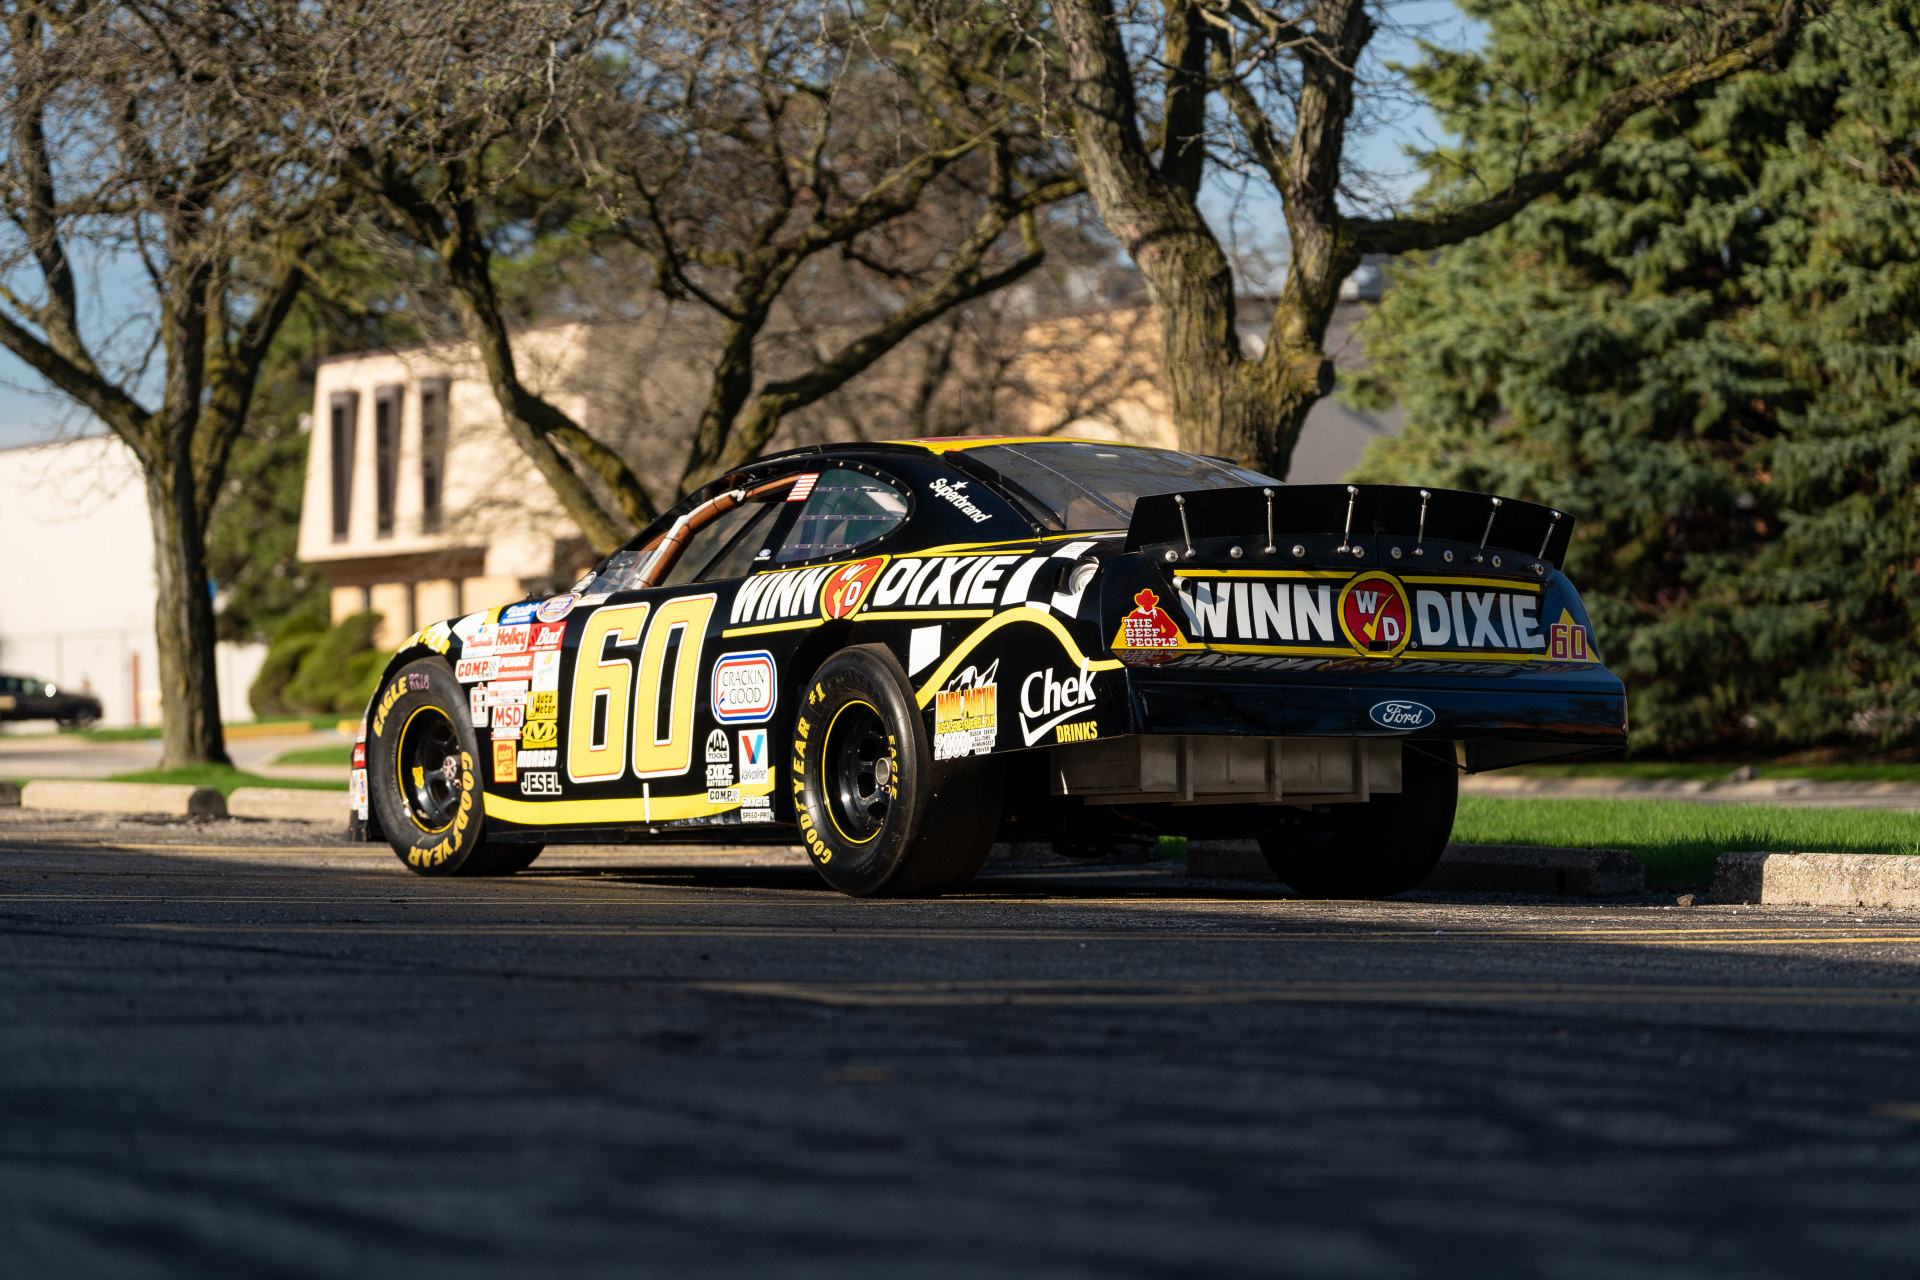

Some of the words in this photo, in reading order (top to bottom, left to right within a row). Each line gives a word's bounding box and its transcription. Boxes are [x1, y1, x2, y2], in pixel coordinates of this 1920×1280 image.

[929, 477, 992, 524] Superbrand
[872, 555, 1022, 607] DIXIE
[730, 567, 829, 624] WINN
[1355, 590, 1378, 614] W
[1123, 618, 1153, 628] THE
[1178, 581, 1335, 642] WINN
[1416, 589, 1546, 649] DIXIE
[495, 626, 528, 651] Holley
[535, 625, 565, 646] Bud
[1125, 628, 1161, 638] BEEF
[1382, 616, 1400, 642] D
[1126, 637, 1178, 647] PEOPLE
[1550, 624, 1588, 661] 60
[457, 660, 489, 678] COMP
[536, 694, 553, 704] Auto
[567, 593, 718, 784] 60
[729, 687, 762, 704] GOOD
[1020, 657, 1097, 719] Chek
[373, 676, 408, 738] EAGLE
[494, 706, 522, 727] MSD
[535, 704, 556, 714] Meter
[1382, 703, 1423, 726] Ford
[708, 732, 728, 752] MAC
[1056, 720, 1098, 744] DRINKS
[522, 773, 560, 793] JESEL
[709, 790, 733, 802] COMP
